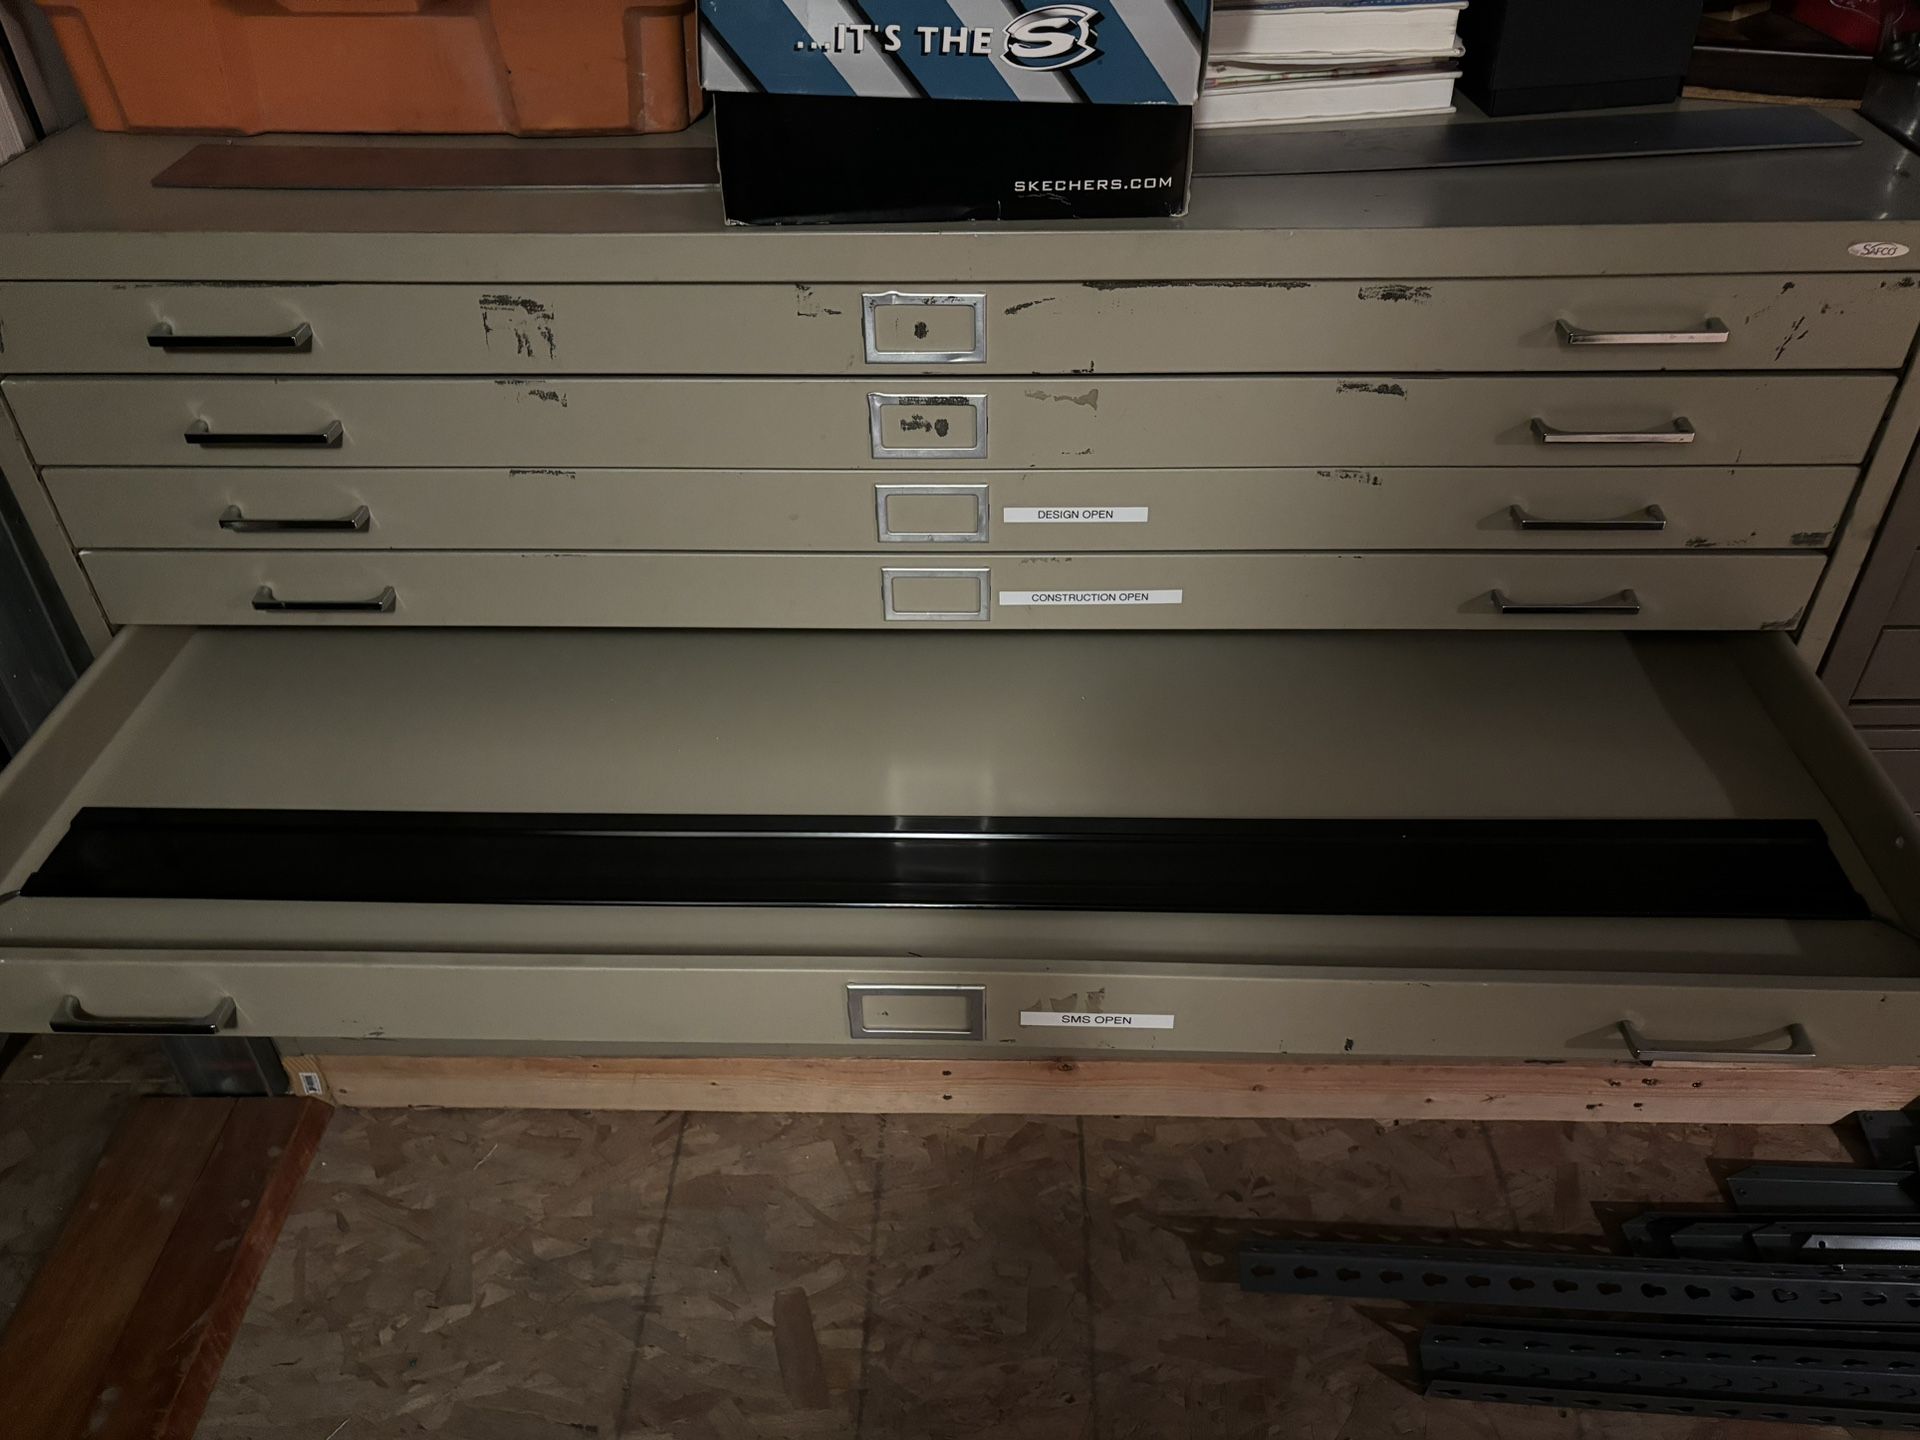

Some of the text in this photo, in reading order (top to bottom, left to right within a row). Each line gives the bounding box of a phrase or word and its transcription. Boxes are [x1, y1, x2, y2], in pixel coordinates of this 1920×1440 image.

[917, 26, 994, 54] THE
[1014, 176, 1173, 192] SKECHERS.COM
[1037, 510, 1114, 519] DESIGN OPEN
[1031, 592, 1149, 602] CONSTRUCTION OPEN
[1061, 1015, 1132, 1024] SMS OPEN
